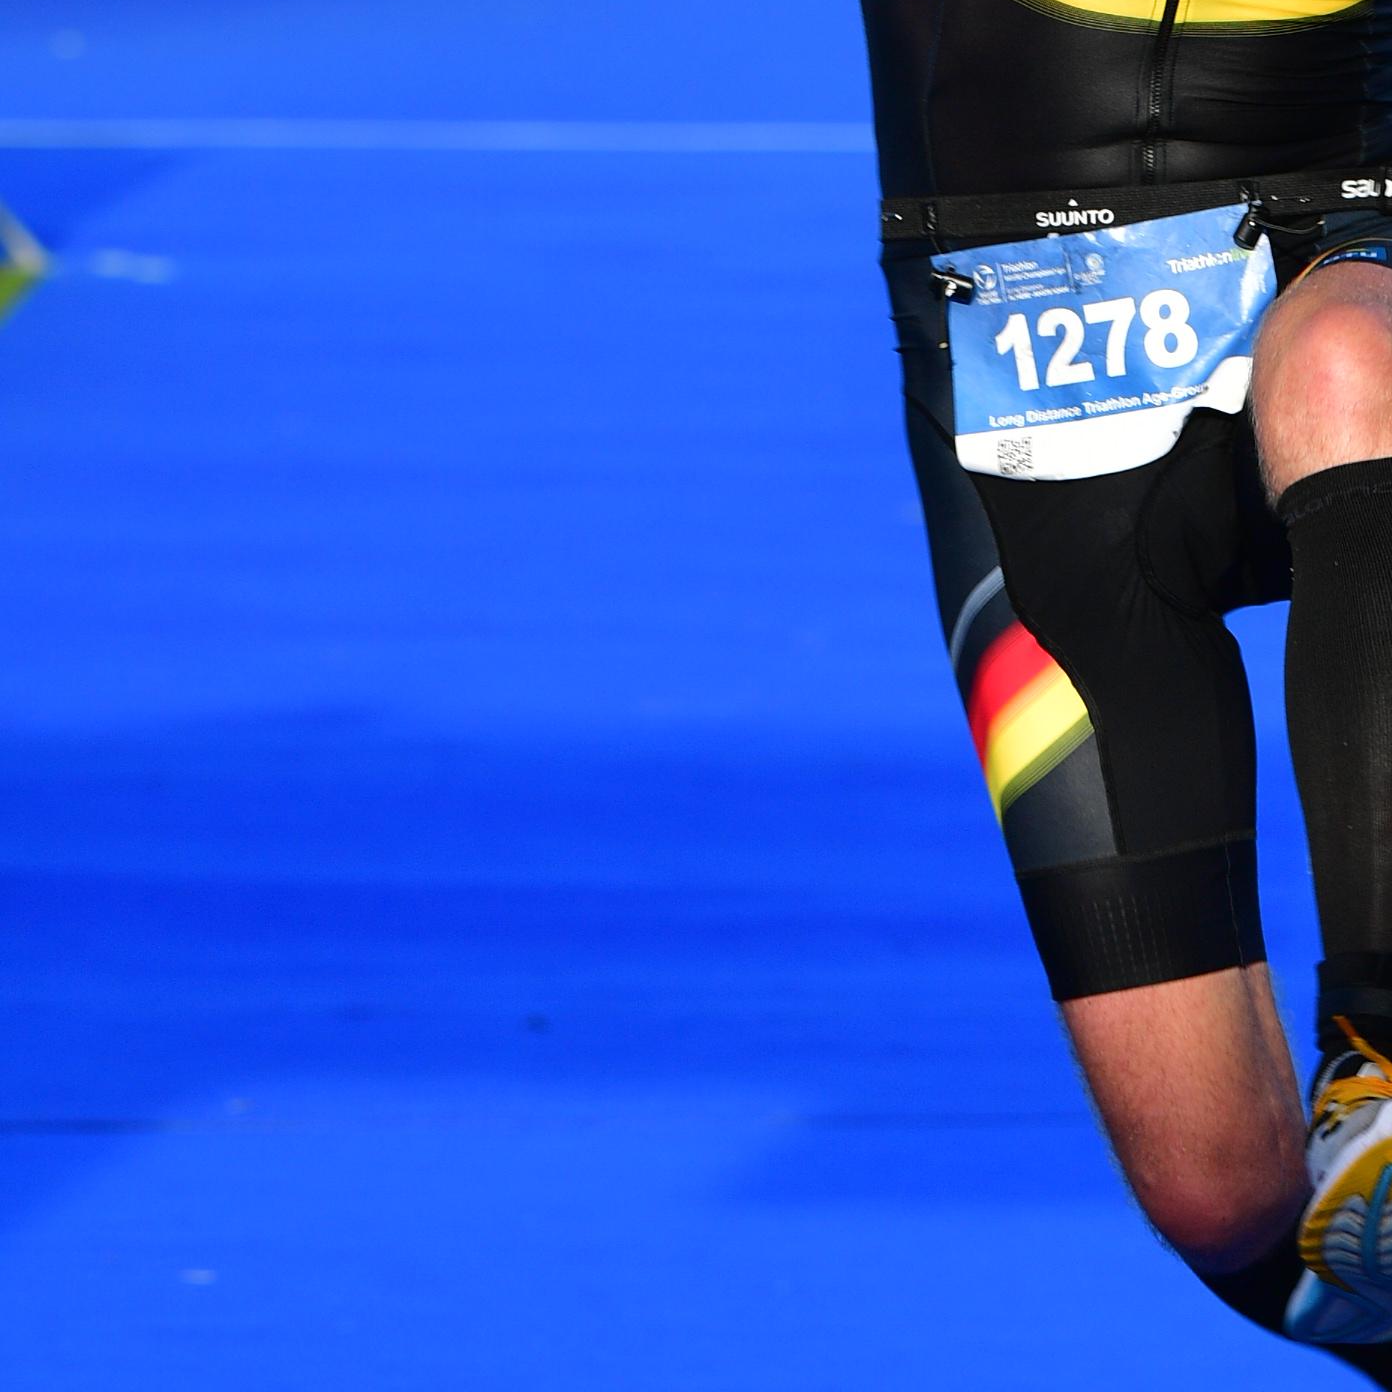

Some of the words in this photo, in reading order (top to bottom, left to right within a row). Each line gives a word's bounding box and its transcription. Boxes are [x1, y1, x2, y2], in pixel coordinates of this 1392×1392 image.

[1036, 208, 1115, 228] SUUNTO
[995, 289, 1199, 392] 1278
[988, 414, 1025, 428] Long
[1025, 406, 1083, 423] Distance
[1082, 395, 1141, 415] Triathlon
[1142, 383, 1209, 407] Age-Grou
